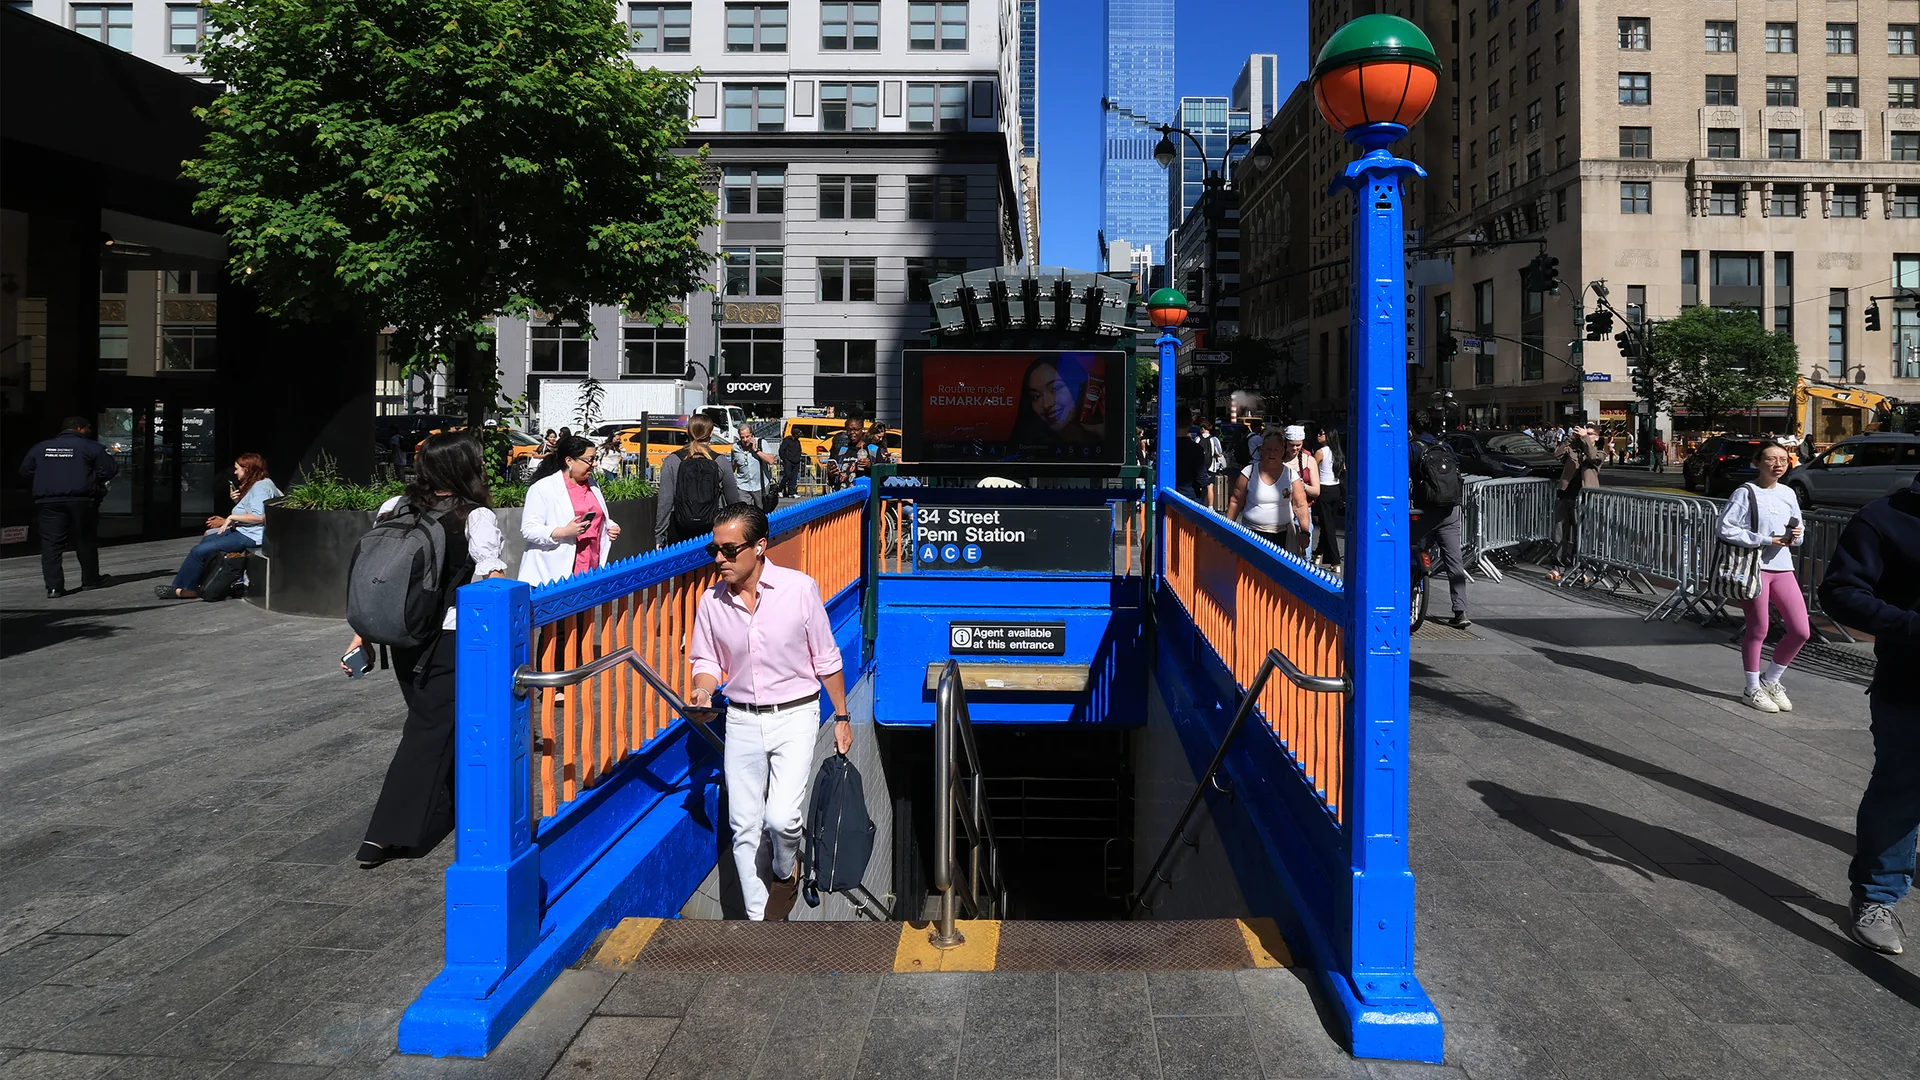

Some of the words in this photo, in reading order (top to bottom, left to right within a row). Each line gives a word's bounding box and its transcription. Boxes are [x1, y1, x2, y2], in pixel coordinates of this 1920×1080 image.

[1405, 280, 1416, 360] YORKER
[726, 382, 772, 394] grocery
[938, 384, 975, 394] Routine
[977, 384, 1005, 394] made
[929, 395, 1013, 406] REMARKABLE
[917, 509, 940, 524] 34
[948, 509, 1000, 524] Street
[917, 527, 957, 542] Penn
[965, 527, 1025, 542] Station
[923, 547, 934, 559] A
[945, 547, 956, 559] C
[967, 547, 977, 559] E
[973, 628, 1004, 639] Agent
[1008, 628, 1052, 638] available
[973, 641, 983, 649] at
[987, 640, 1006, 649] this
[1009, 641, 1055, 650] entrance
